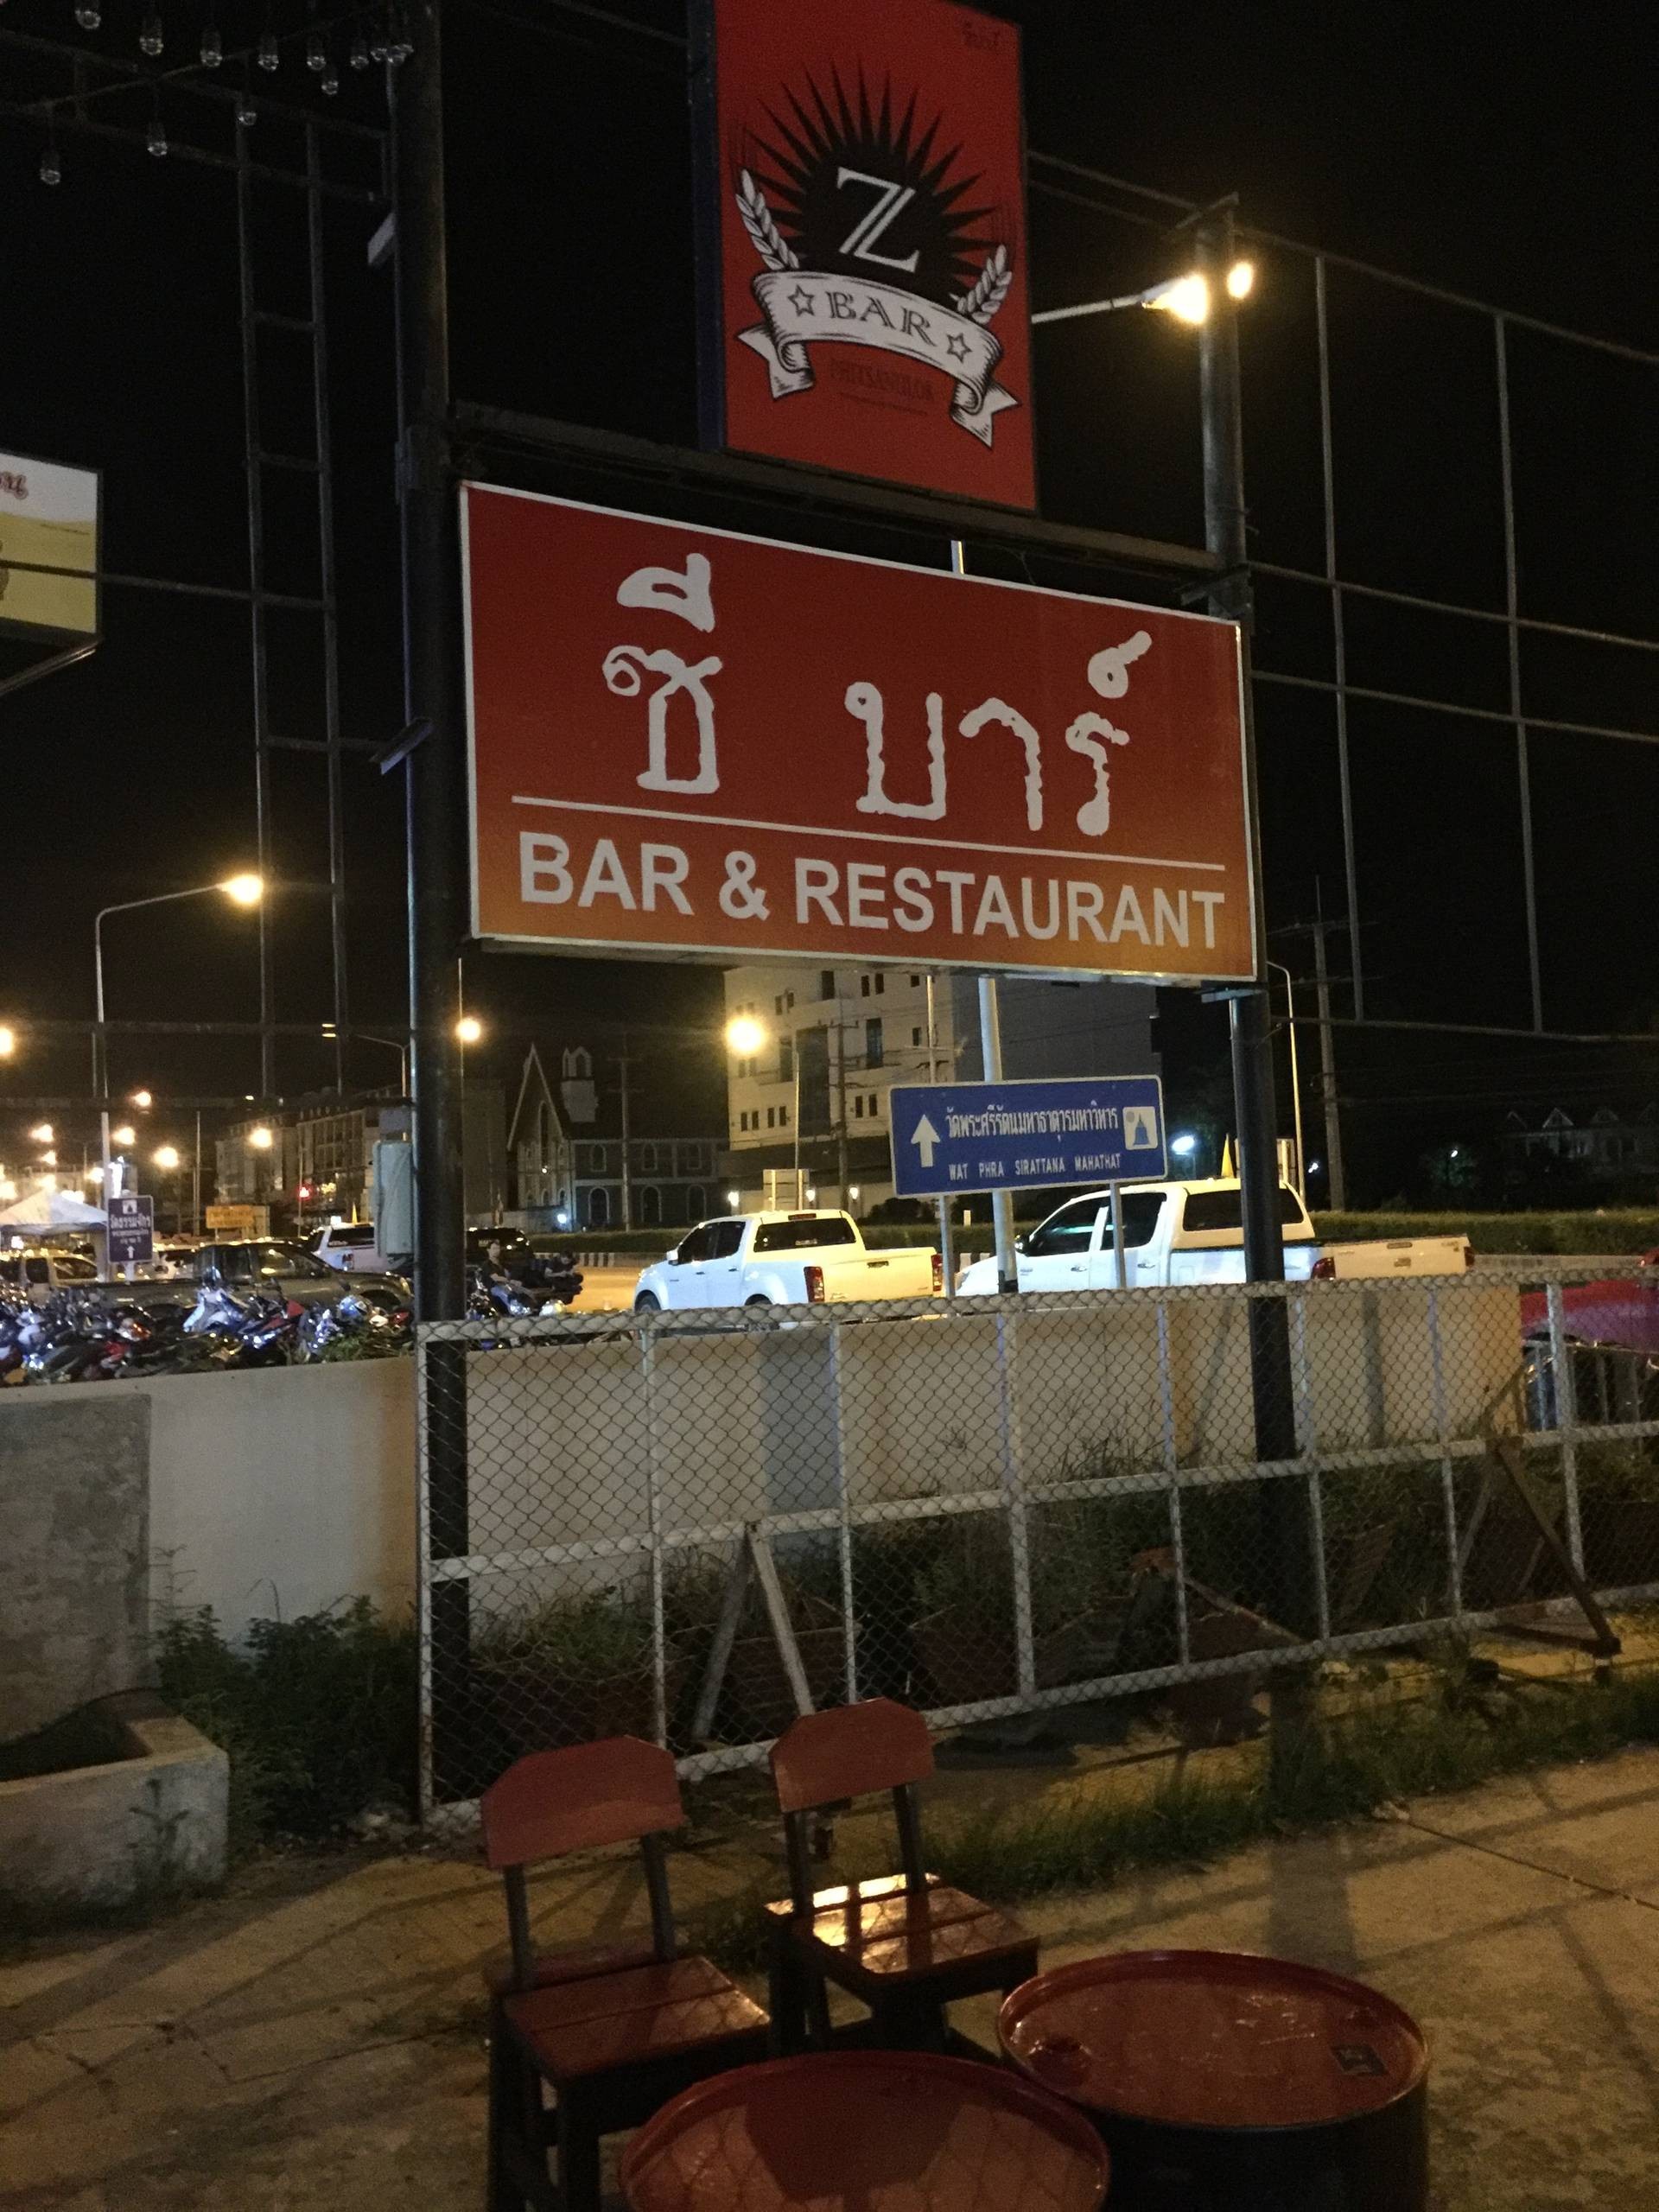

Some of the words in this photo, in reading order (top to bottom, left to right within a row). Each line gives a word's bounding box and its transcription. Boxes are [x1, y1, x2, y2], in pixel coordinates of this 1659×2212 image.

[836, 167, 919, 273] Z
[825, 289, 938, 346] BAR
[844, 630, 1152, 836] บาร์
[519, 831, 694, 916] BAR
[718, 850, 771, 920] &
[794, 857, 1225, 949] RESTAURANT
[948, 1163, 969, 1181] WAT
[978, 1160, 1005, 1179] PHRA
[1014, 1157, 1065, 1176] SIRATTANA
[1074, 1153, 1122, 1172] MAHATHAT
